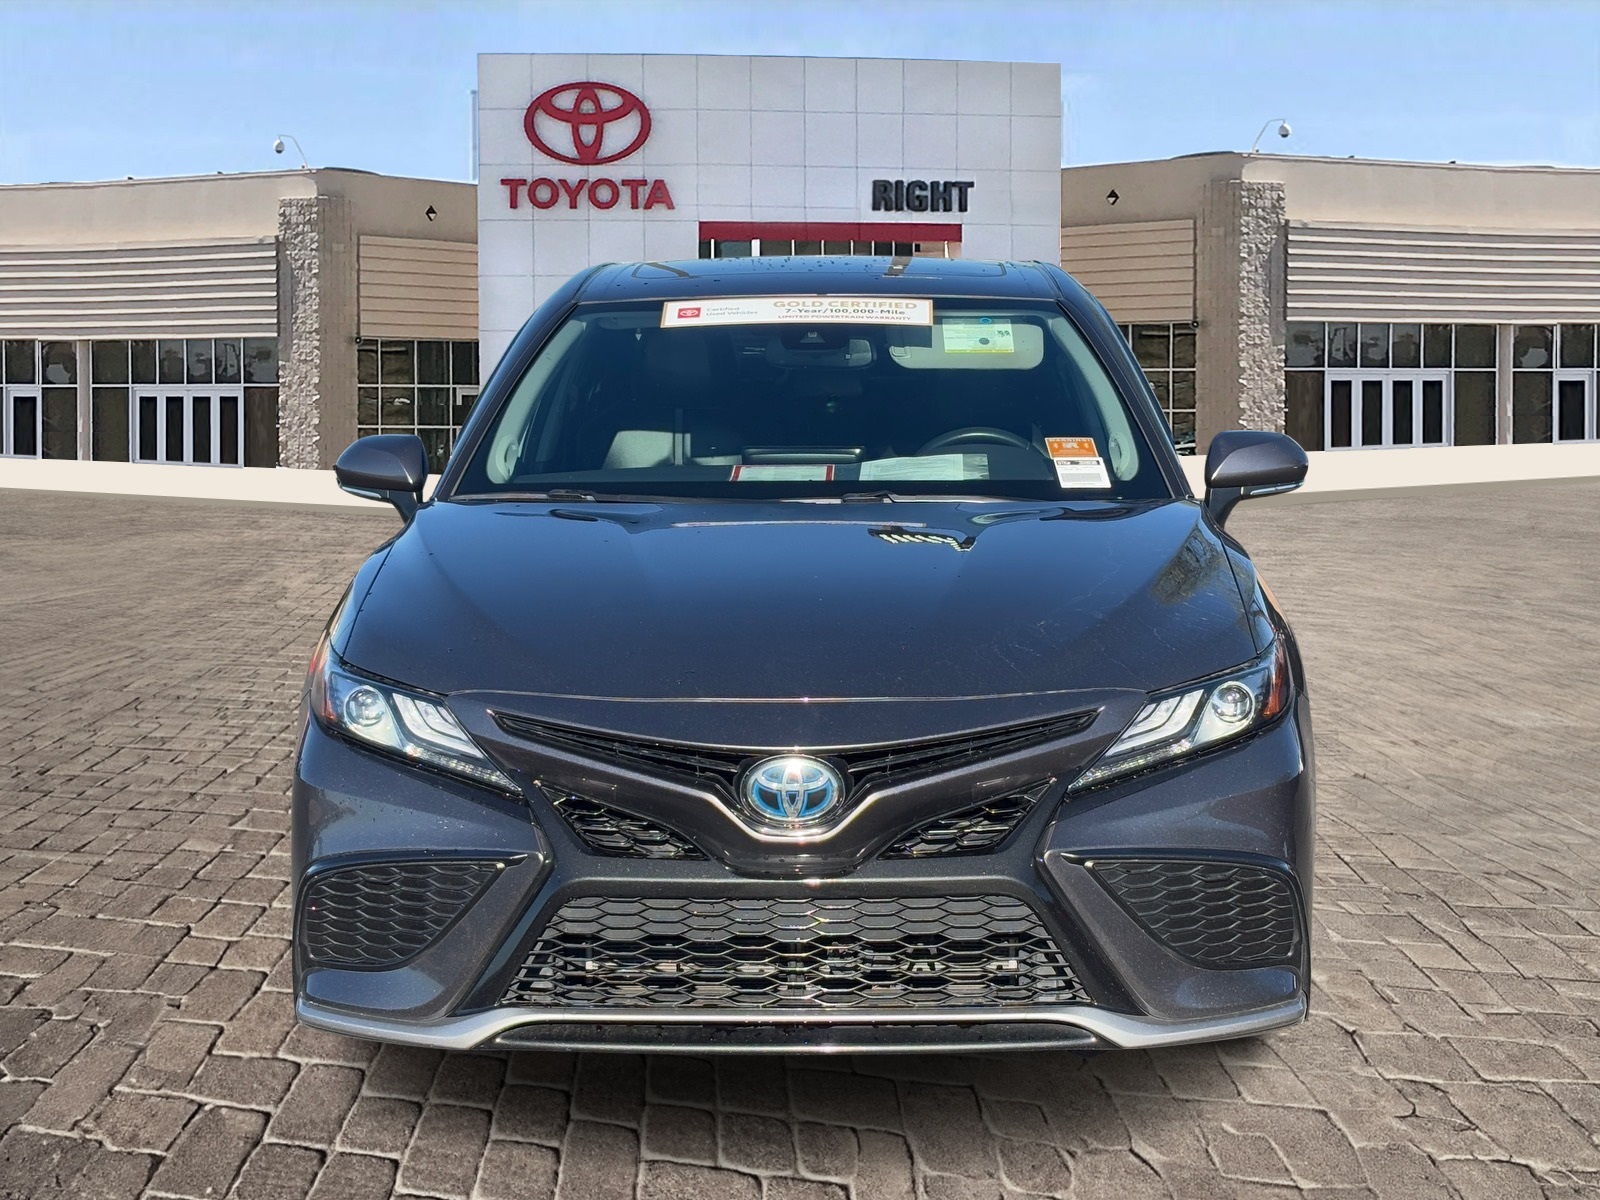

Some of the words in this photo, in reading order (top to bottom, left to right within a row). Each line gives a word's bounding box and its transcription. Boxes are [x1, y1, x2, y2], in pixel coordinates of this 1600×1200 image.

[500, 178, 675, 210] TOYOTA
[872, 179, 975, 212] RIGHT
[773, 300, 824, 308] GOLD
[828, 300, 918, 310] CERTIFIED
